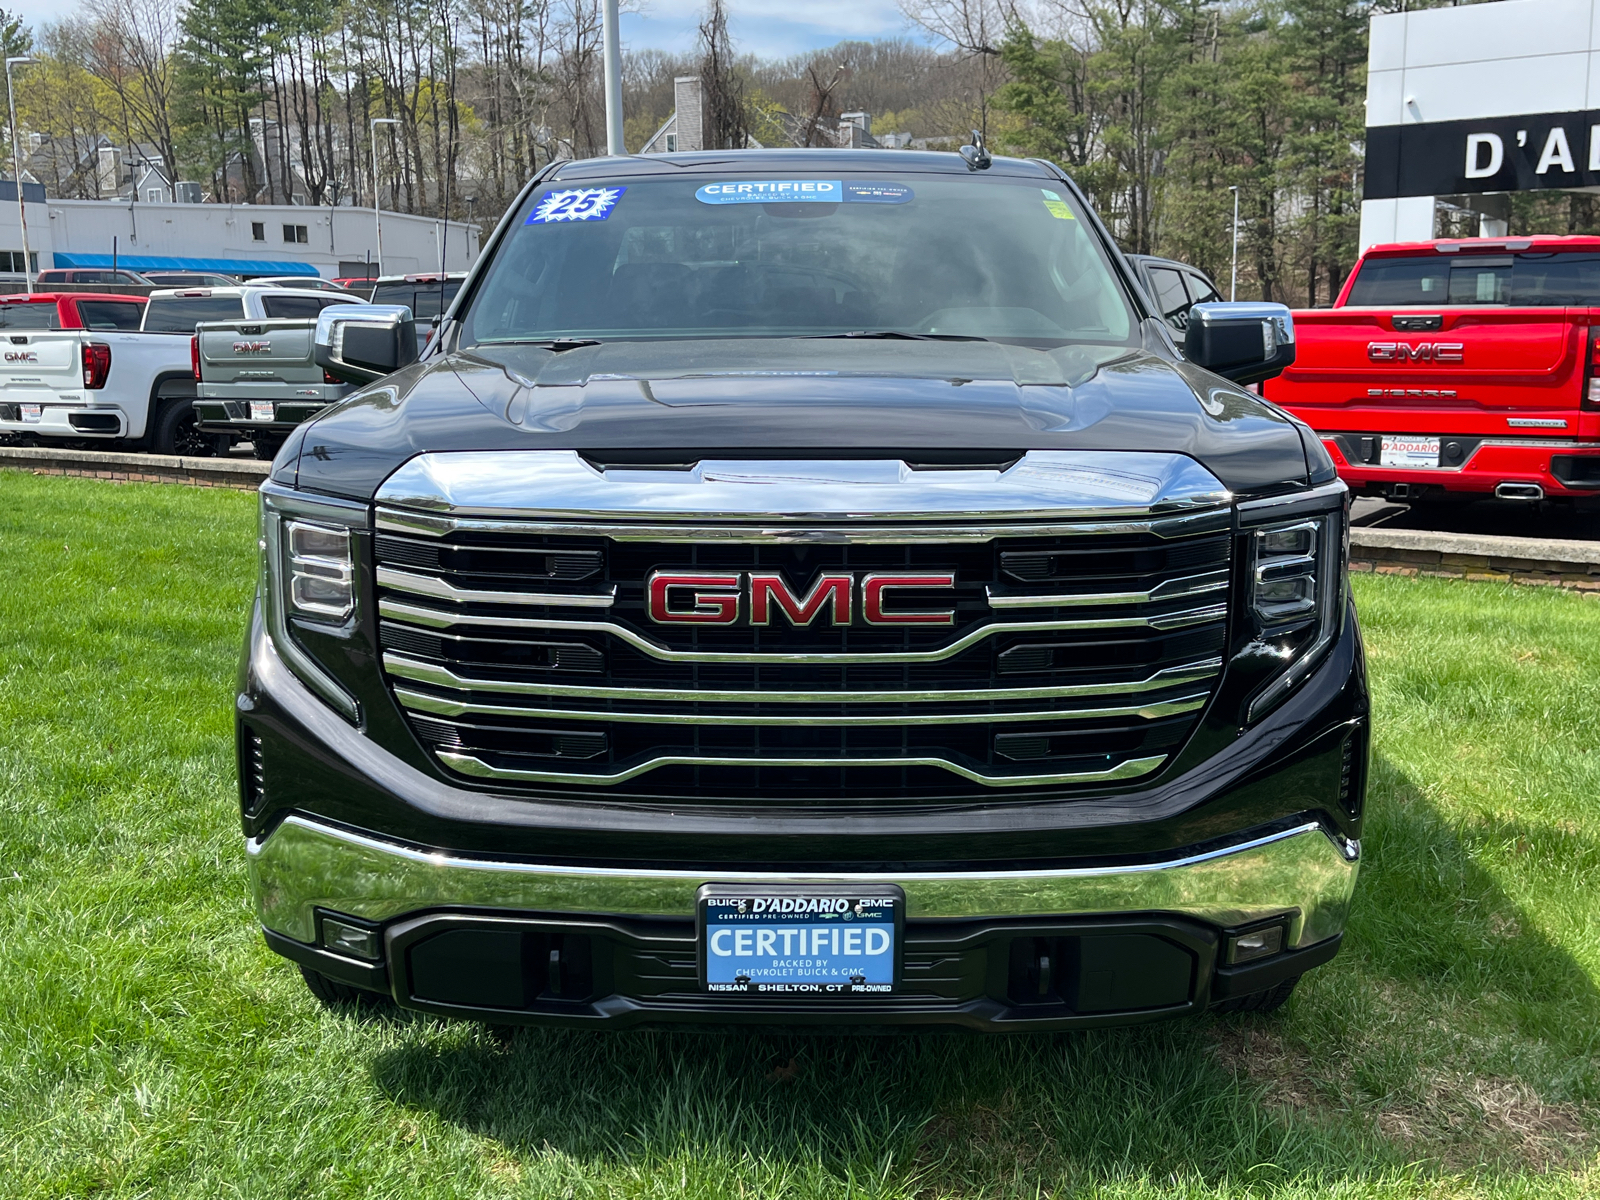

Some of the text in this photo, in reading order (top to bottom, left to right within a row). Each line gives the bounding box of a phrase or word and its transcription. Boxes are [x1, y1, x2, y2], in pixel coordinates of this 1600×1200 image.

[704, 183, 834, 194] CERTIFIED
[549, 193, 602, 215] 25
[233, 340, 271, 353] GMC
[1367, 341, 1464, 361] GMC
[4, 351, 38, 361] GMC
[1382, 443, 1439, 453] D'ADDARIO
[649, 570, 955, 627] GMC
[707, 898, 893, 913] BUICK D'ADDARIO GMC
[710, 928, 890, 957] CERTIFIED
[772, 959, 828, 967] BACKED BY
[735, 968, 865, 976] CHEVROLET BUICK & GMC
[708, 984, 748, 992] NISSAN
[758, 984, 823, 993] SHELTON,
[825, 984, 844, 992] CT
